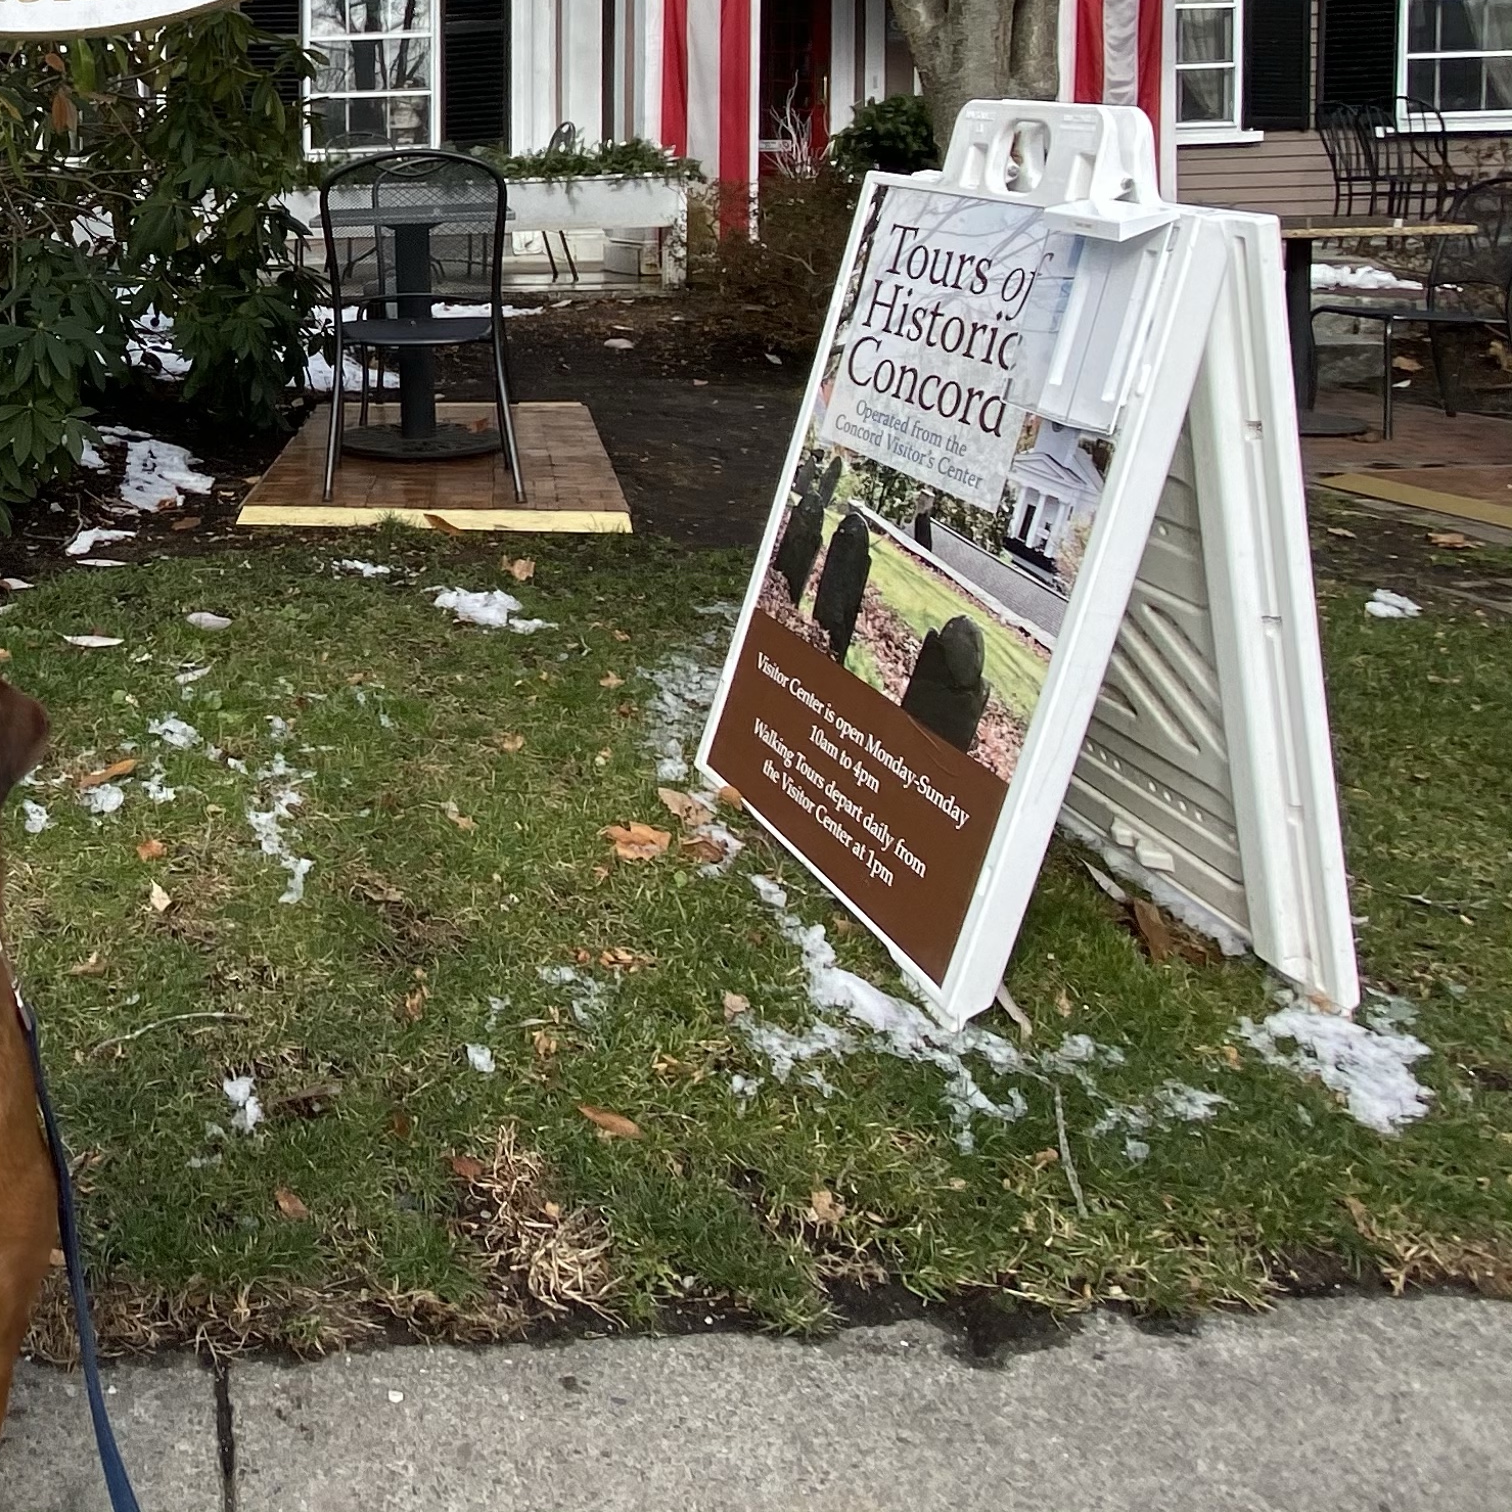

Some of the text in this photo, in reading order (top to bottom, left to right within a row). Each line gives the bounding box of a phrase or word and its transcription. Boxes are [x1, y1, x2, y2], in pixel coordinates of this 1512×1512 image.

[886, 224, 1054, 320] Tours of
[862, 280, 1022, 370] Historic
[836, 414, 884, 447] Concord
[938, 456, 983, 489] Center
[856, 400, 967, 456] Operated from the
[757, 652, 970, 829] Visitor Center is open Monday-Sunday
[809, 725, 880, 793] 10am to 4pm
[754, 718, 927, 878] Walking Tours depart daily from
[763, 759, 894, 887] the Visitor Center at 1pm
